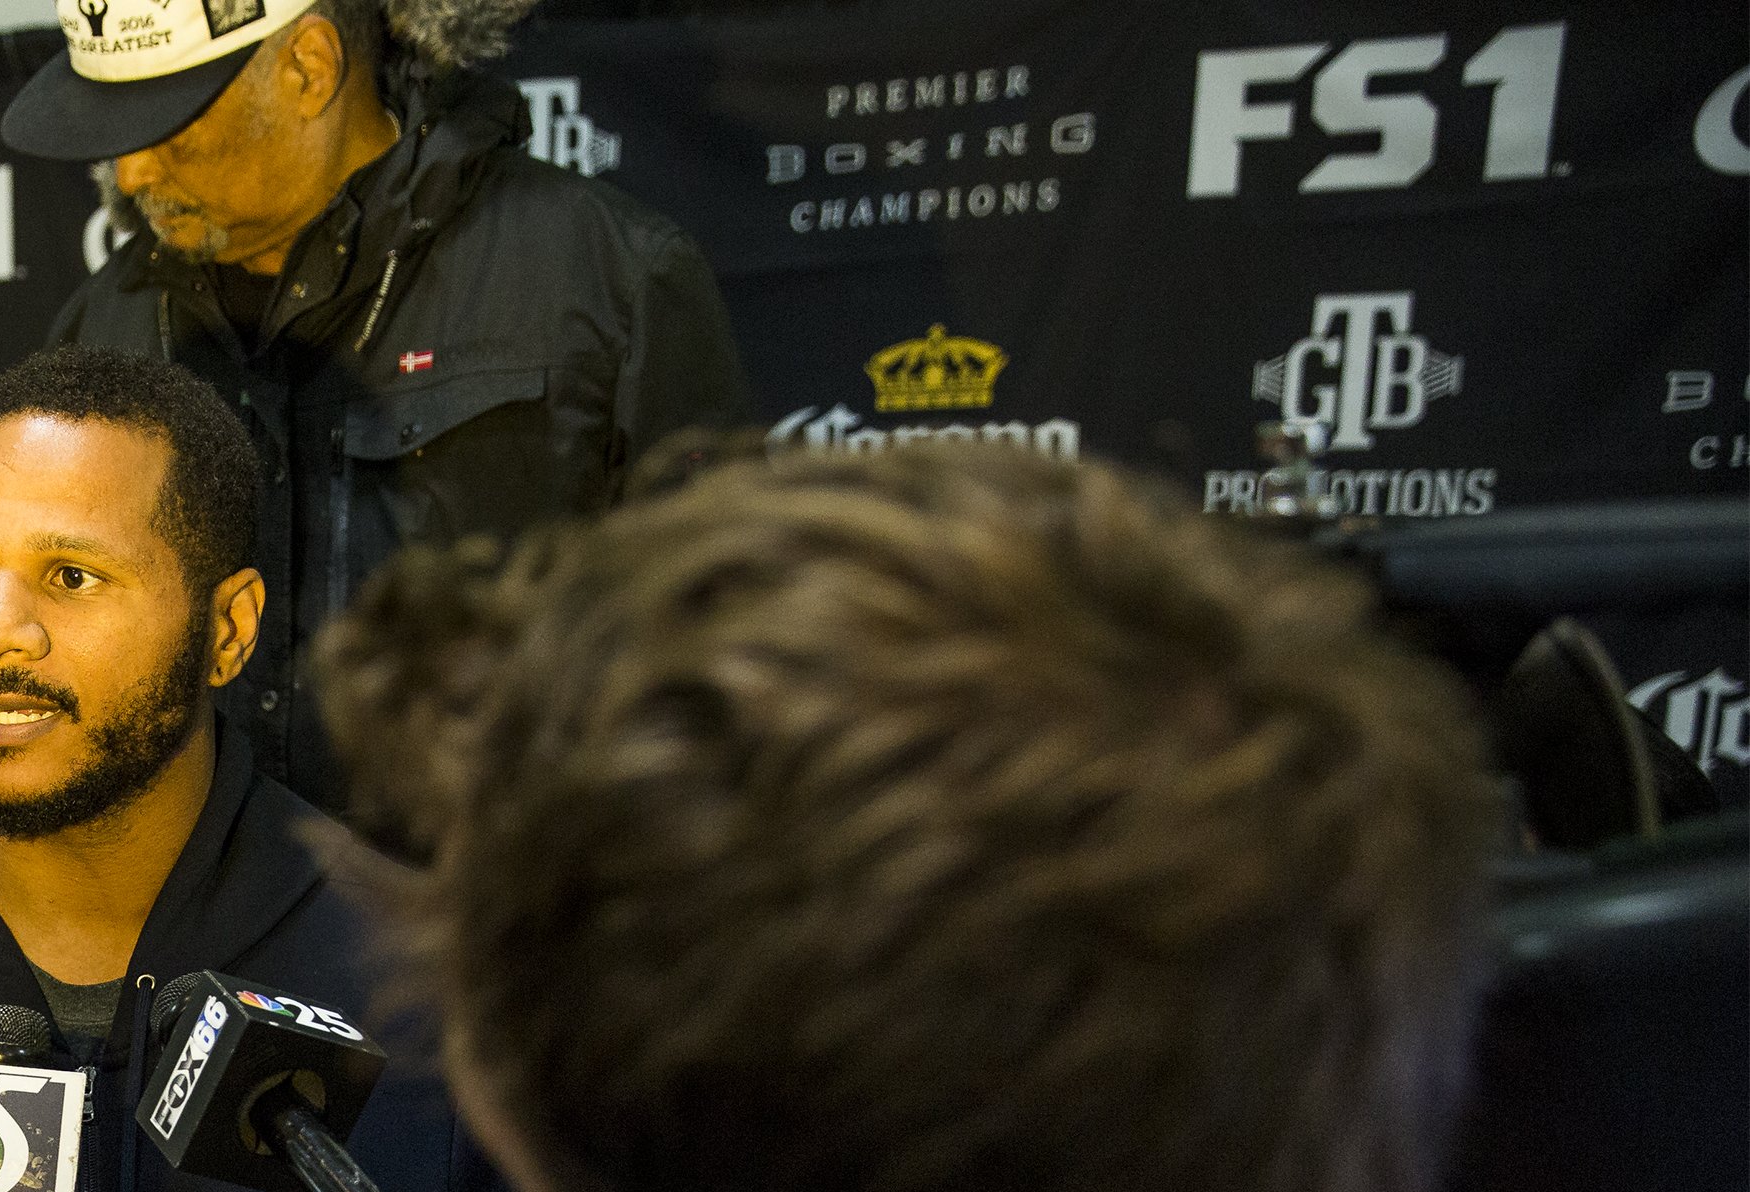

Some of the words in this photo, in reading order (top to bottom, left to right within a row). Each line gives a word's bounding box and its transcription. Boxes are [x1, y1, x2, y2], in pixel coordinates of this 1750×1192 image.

[827, 65, 1031, 118] PREMIER
[1187, 20, 1567, 199] FS1
[766, 112, 1096, 185] BOXING
[790, 178, 1061, 233] CHAMPIONS
[274, 996, 364, 1041] 25
